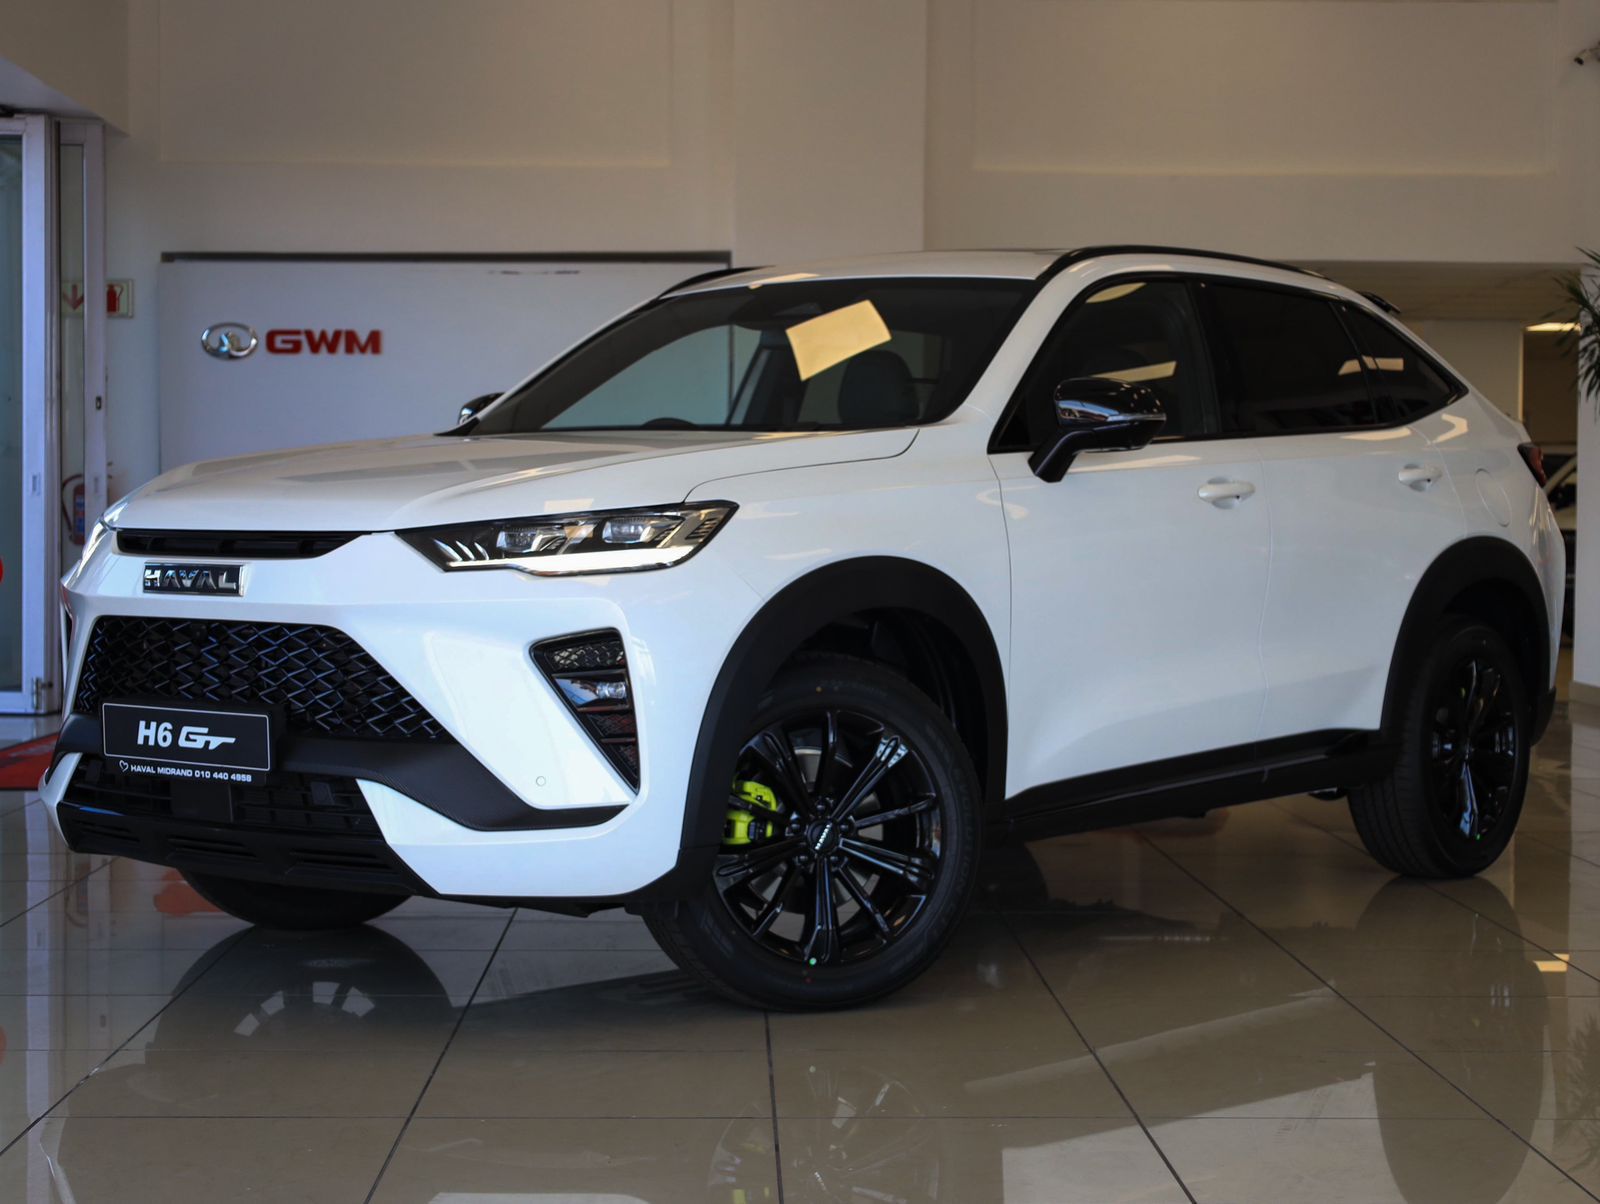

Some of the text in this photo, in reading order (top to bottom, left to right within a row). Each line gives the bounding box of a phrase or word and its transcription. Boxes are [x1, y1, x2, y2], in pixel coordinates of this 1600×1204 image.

[265, 328, 383, 355] GWM
[143, 569, 237, 590] HAVAL
[136, 720, 236, 750] H6 GT
[130, 764, 156, 775] HAVAL
[157, 767, 193, 778] MIDRAND
[194, 770, 211, 779] 010
[212, 771, 229, 781] 440
